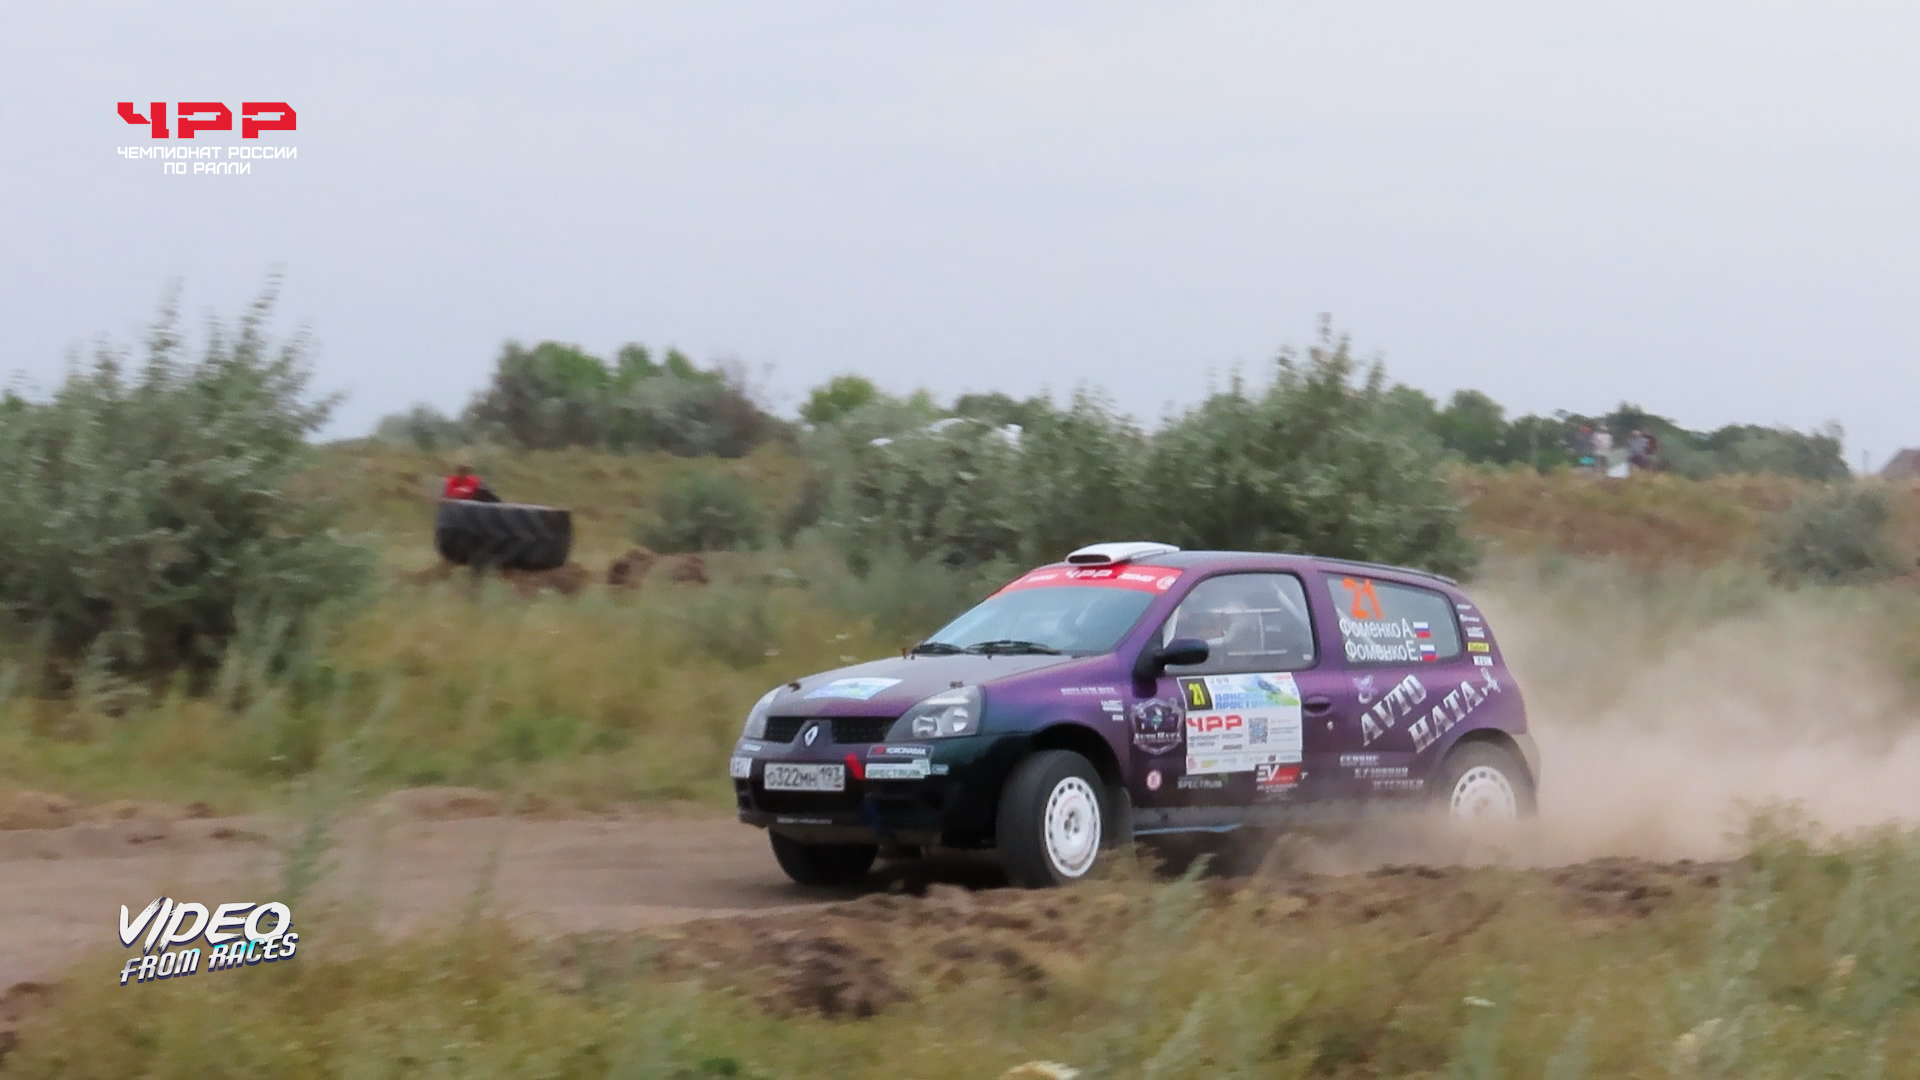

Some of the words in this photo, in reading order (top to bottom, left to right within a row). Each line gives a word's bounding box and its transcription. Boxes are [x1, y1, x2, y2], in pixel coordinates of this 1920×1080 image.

[1342, 577, 1384, 620] 21
[1339, 618, 1401, 638] Фоменко
[1187, 683, 1206, 706] 21
[1361, 674, 1427, 747] AVTO
[1187, 714, 1243, 732] ЧРР
